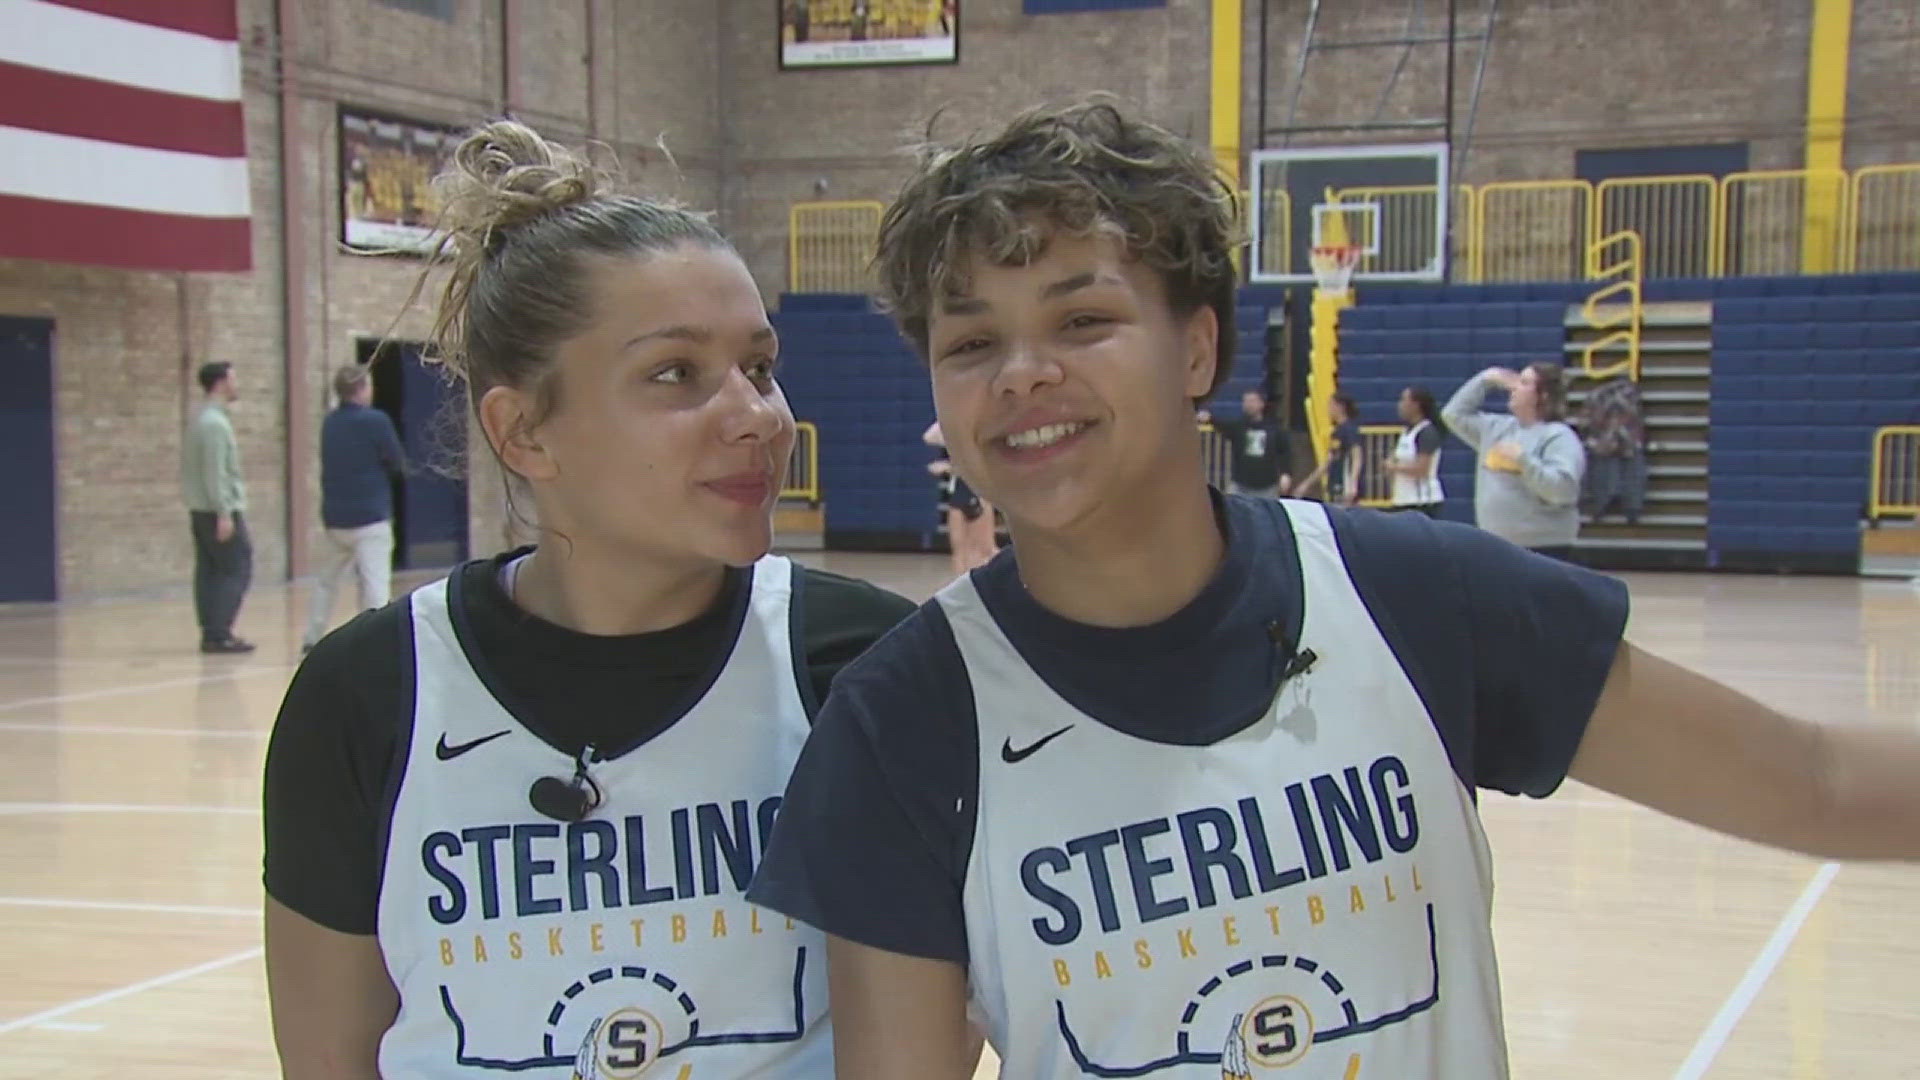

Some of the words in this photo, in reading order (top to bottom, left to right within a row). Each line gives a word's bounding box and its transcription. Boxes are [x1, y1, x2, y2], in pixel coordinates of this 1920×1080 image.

[1019, 755, 1420, 946] STERLING
[1053, 863, 1423, 987] BASKETBALL
[606, 1020, 647, 1069] S
[1254, 1004, 1297, 1058] S
